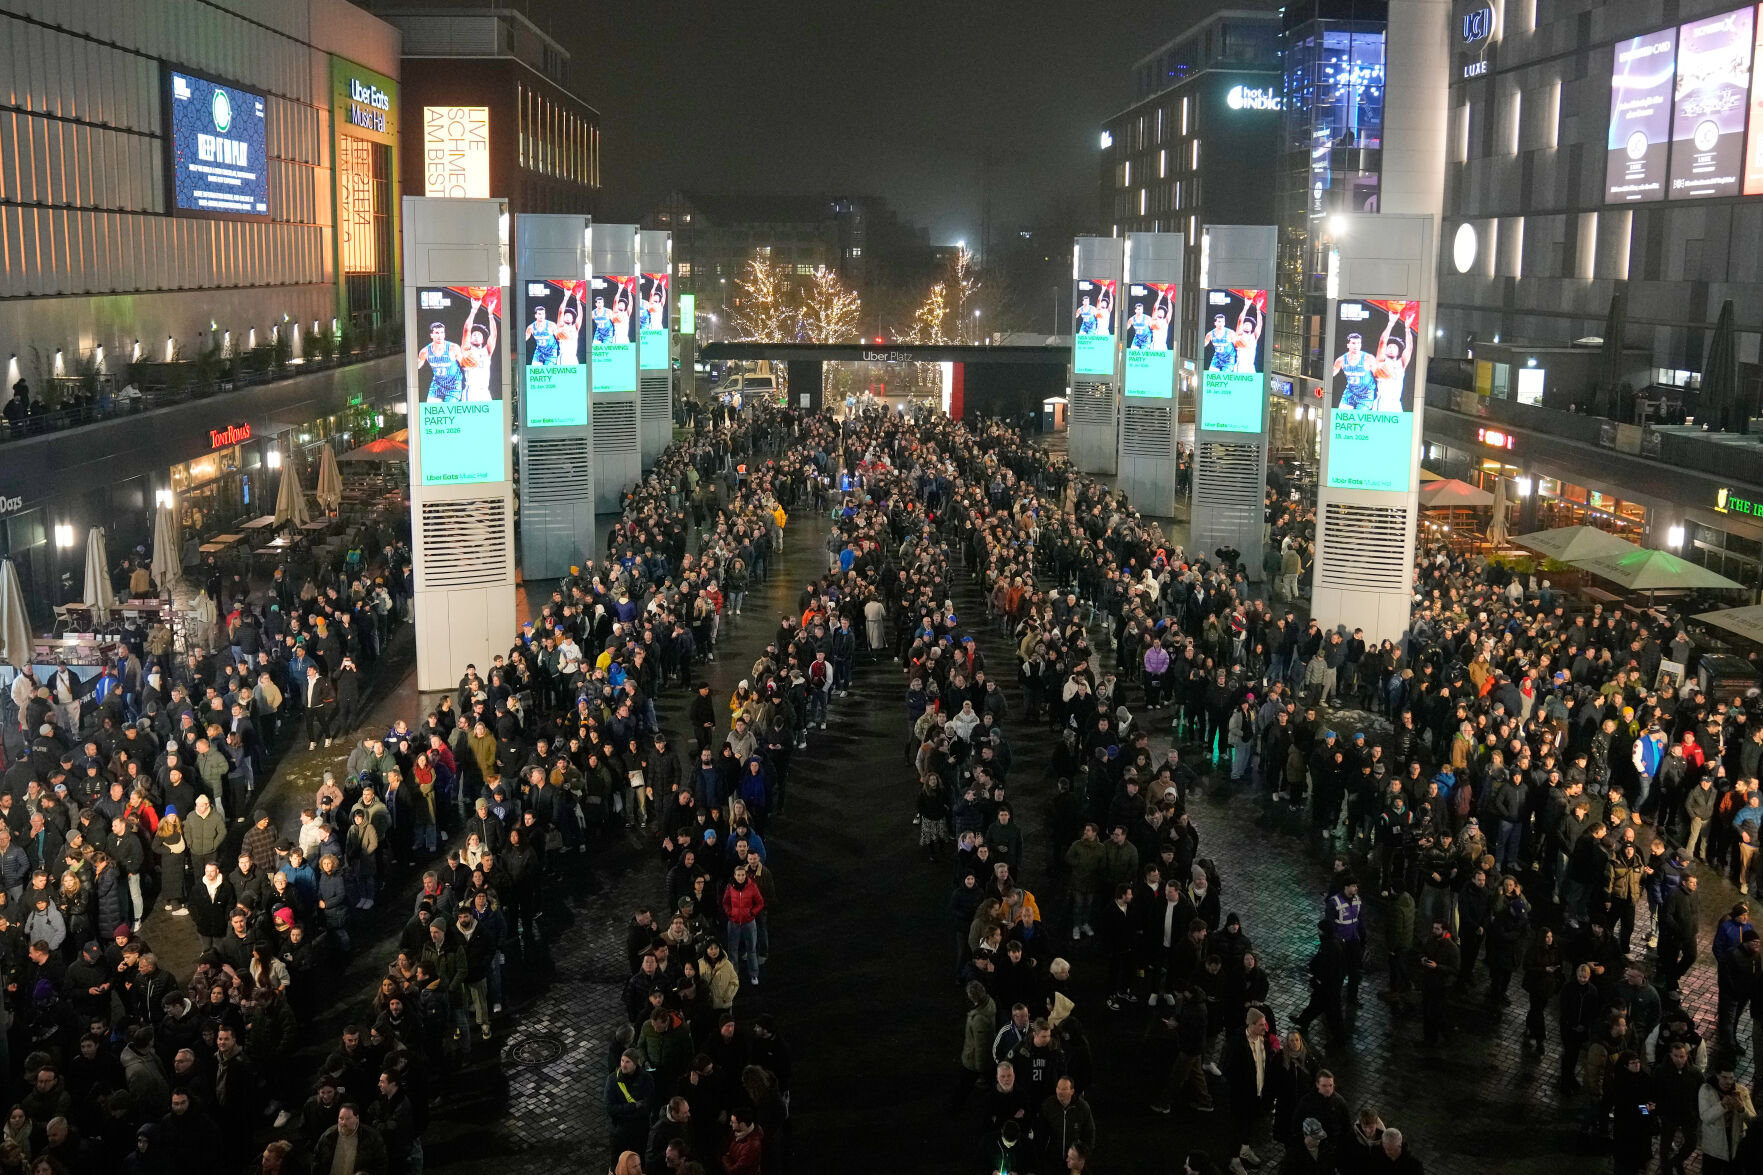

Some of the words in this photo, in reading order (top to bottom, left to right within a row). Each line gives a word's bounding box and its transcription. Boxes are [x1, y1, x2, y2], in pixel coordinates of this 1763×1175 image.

[1464, 60, 1487, 78] LUXE
[351, 78, 371, 105] Uber
[370, 85, 389, 111] Eats
[351, 103, 373, 130] Music
[373, 110, 386, 133] Hall
[427, 107, 444, 143] AM
[469, 108, 486, 151] LIVE
[428, 149, 446, 198] BEST
[862, 351, 888, 361] Uber
[890, 351, 913, 362] Platz
[1206, 380, 1228, 388] PARTY
[1223, 374, 1254, 382] VIEWING
[424, 406, 446, 415] NBA
[446, 404, 490, 414] VIEWING
[424, 416, 456, 425] PARTY
[1335, 412, 1356, 421] NBA
[1357, 413, 1399, 424] VIEWING
[1335, 422, 1365, 432] PARTY
[1332, 476, 1347, 484] Uber
[1347, 477, 1363, 485] Eats
[1729, 497, 1751, 514] THE
[1032, 1069, 1042, 1081] 21
